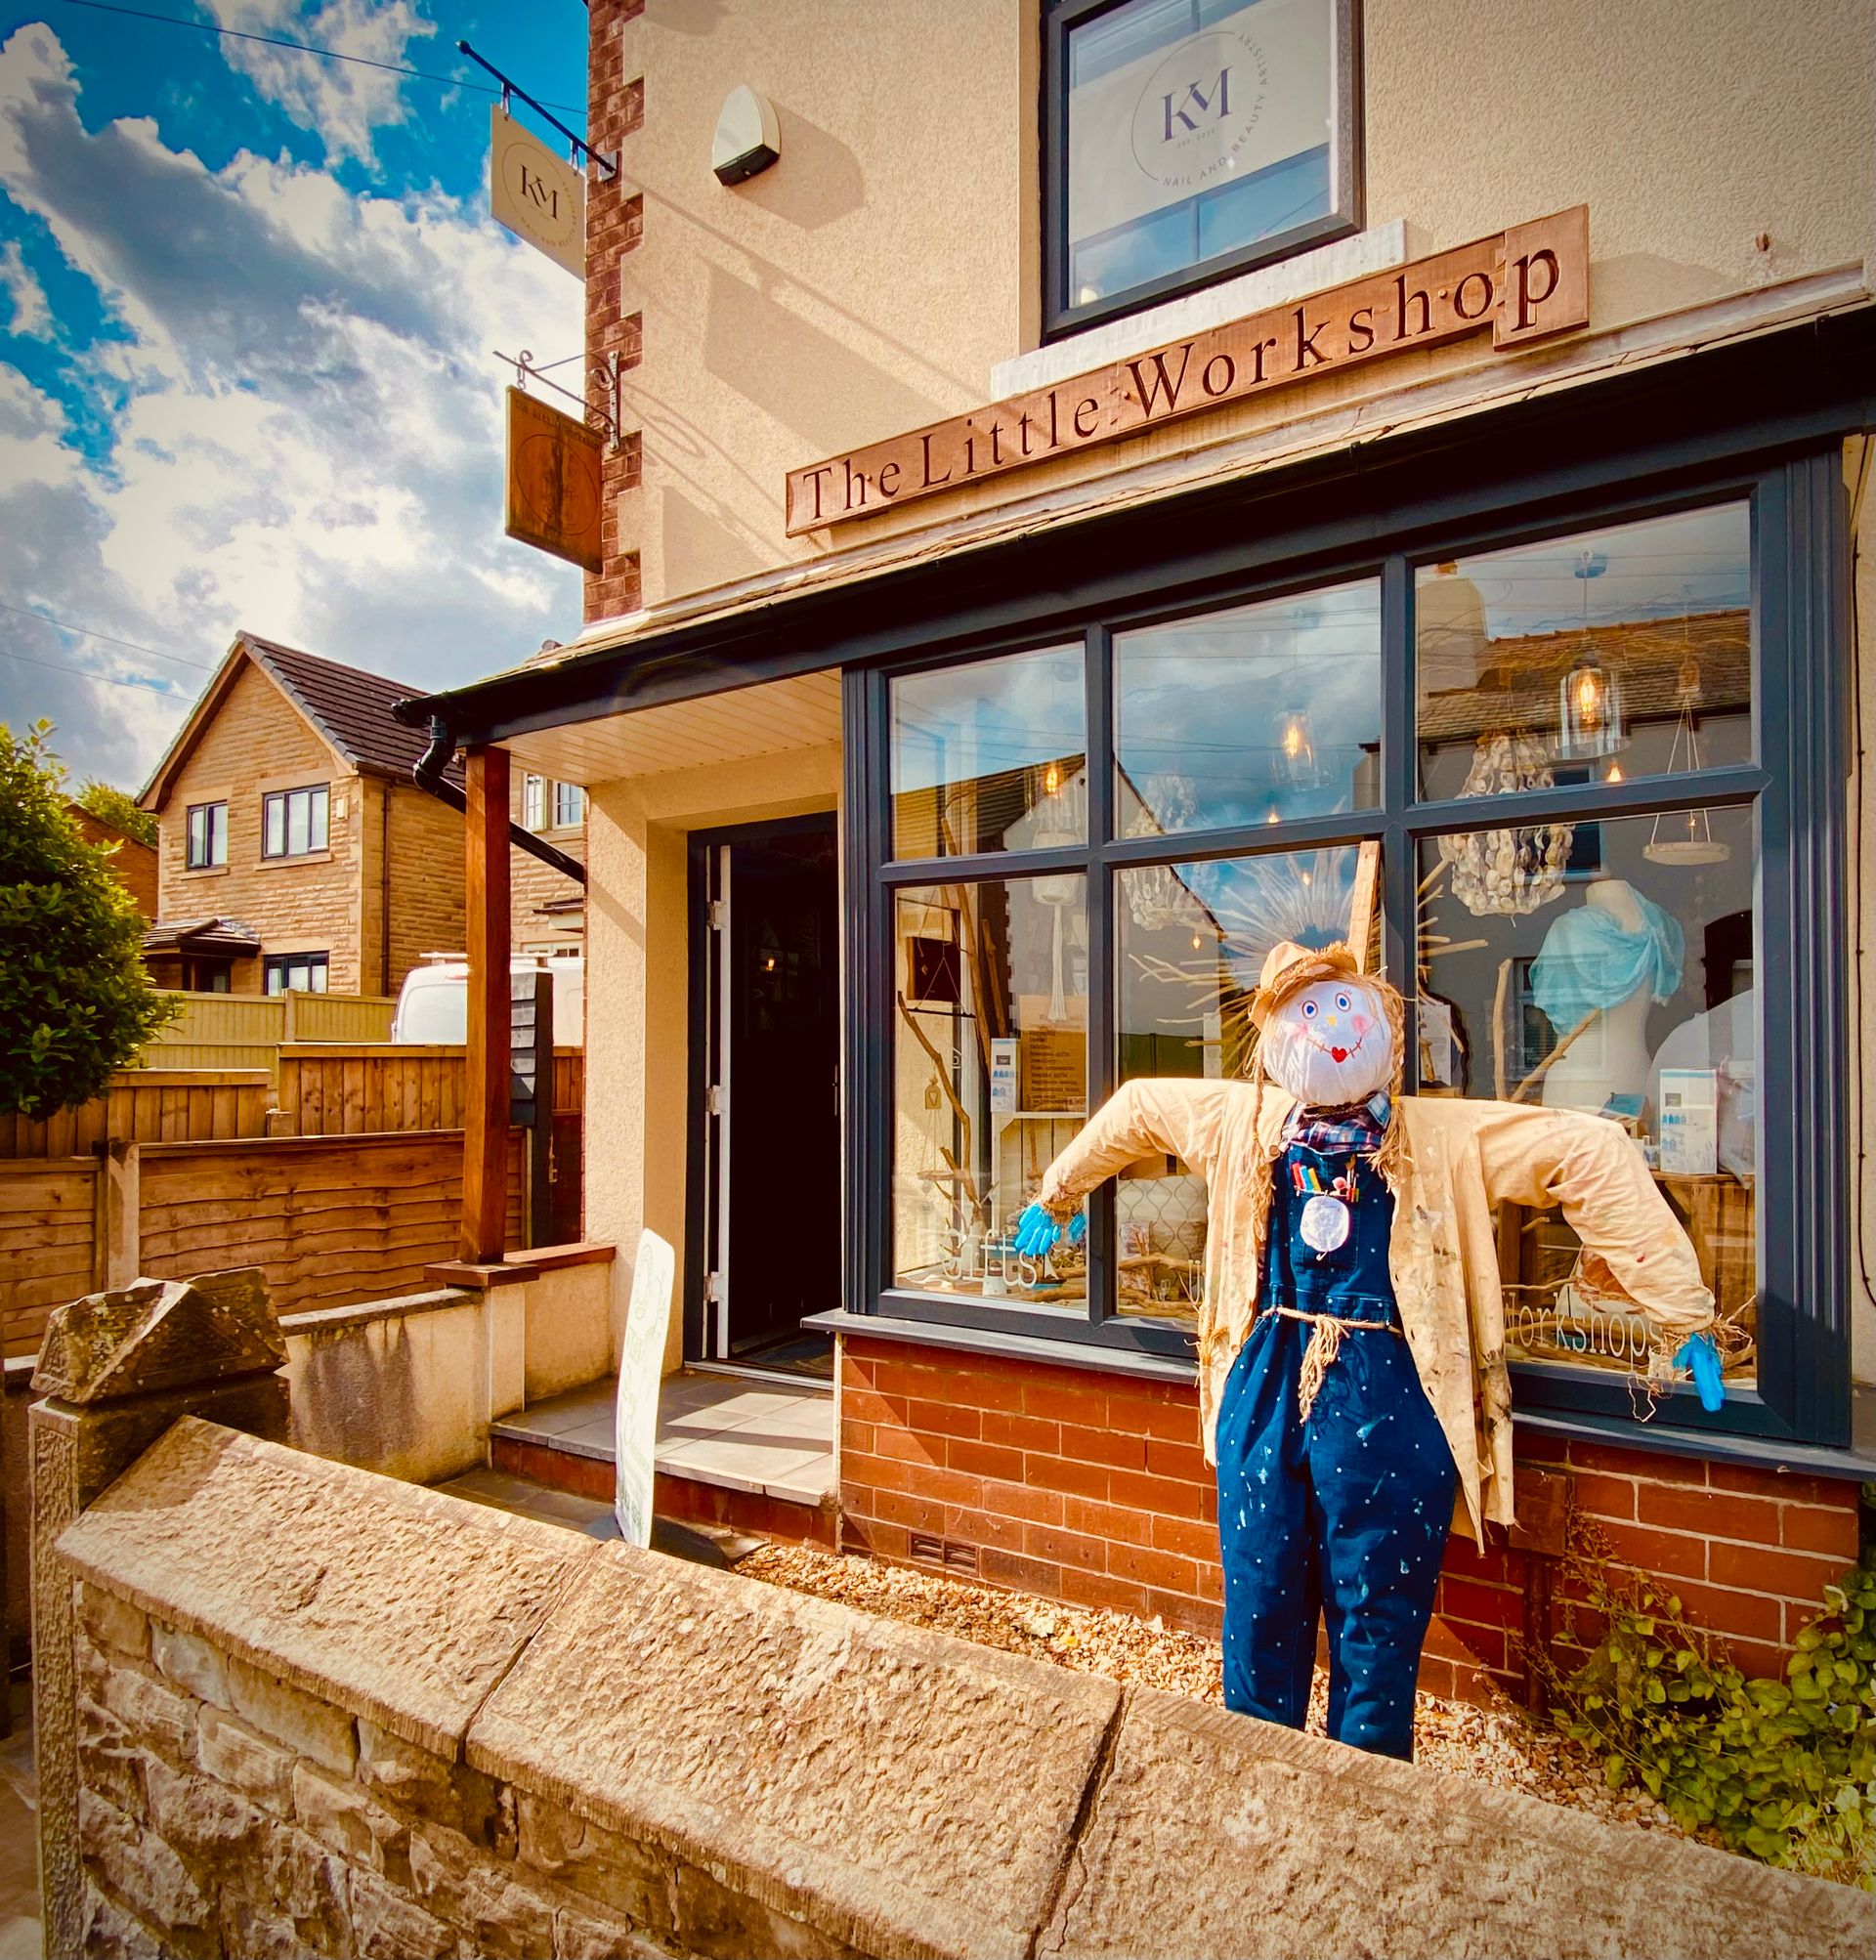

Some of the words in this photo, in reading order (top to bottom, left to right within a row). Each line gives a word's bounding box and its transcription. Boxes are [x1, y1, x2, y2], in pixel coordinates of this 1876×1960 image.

[1237, 31, 1268, 86] ARTISTRY
[1160, 65, 1234, 144] KM
[1231, 94, 1266, 152] BEAUTY
[519, 164, 559, 222] KM
[1163, 177, 1193, 187] NAIL
[1199, 156, 1227, 180] AND
[803, 458, 901, 520] The
[919, 391, 1100, 489] Little
[1125, 247, 1561, 420] Workshop
